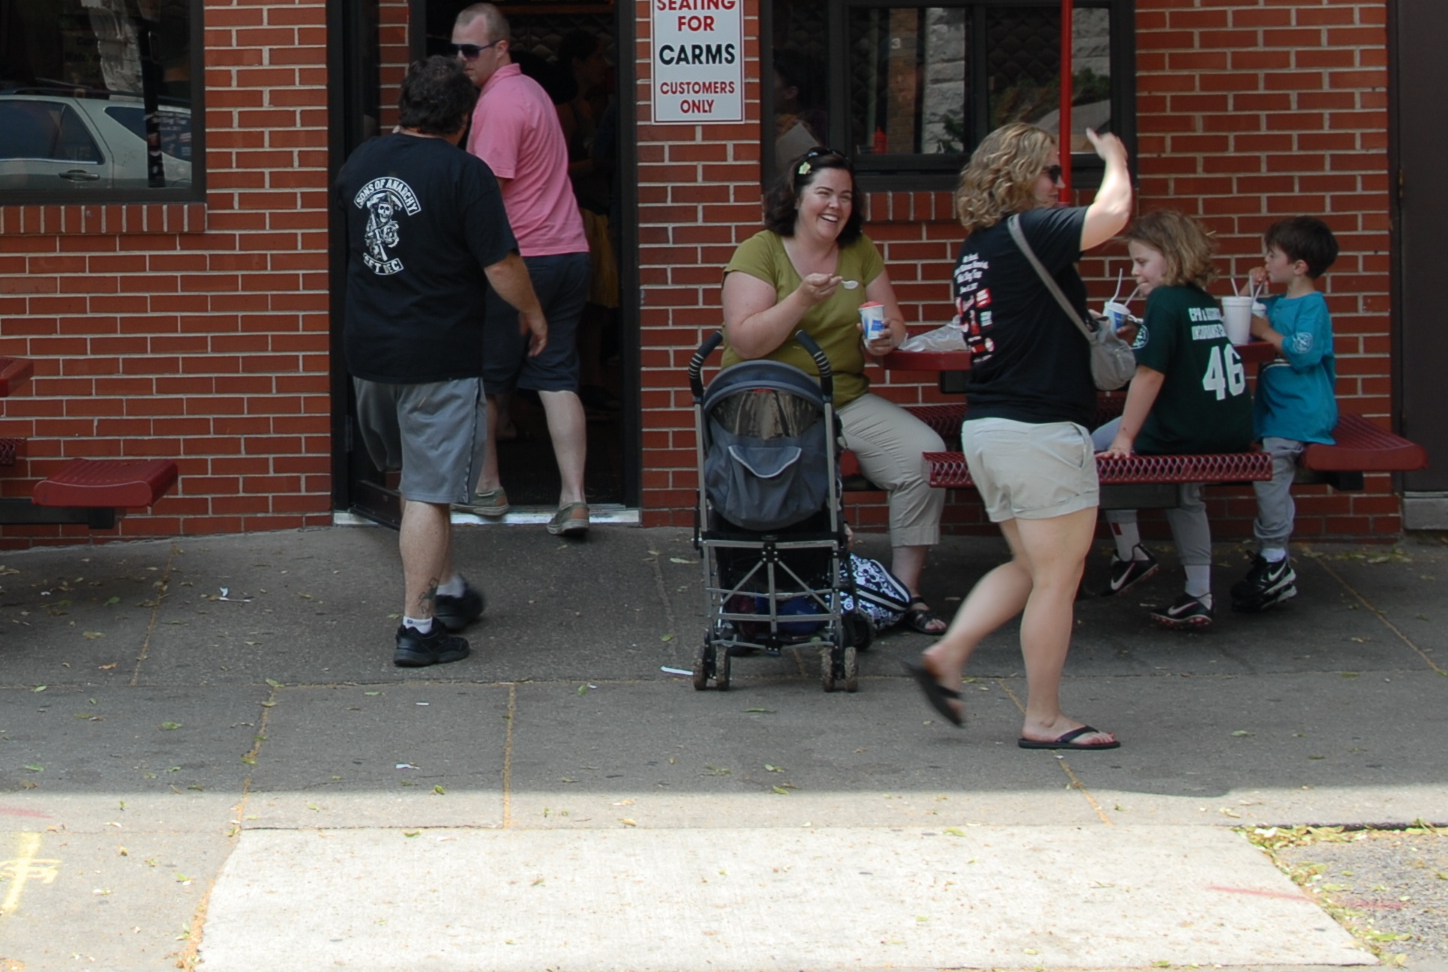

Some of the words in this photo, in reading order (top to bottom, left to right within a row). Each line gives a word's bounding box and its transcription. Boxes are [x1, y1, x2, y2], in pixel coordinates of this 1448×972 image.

[677, 15, 715, 31] FOR
[659, 43, 735, 66] CARMS
[660, 81, 735, 95] CUSTOMERS
[680, 99, 715, 113] ONLY
[356, 183, 375, 206] SONS
[374, 179, 386, 190] OF
[385, 179, 418, 213] ANARCHY
[1202, 343, 1245, 401] 46
